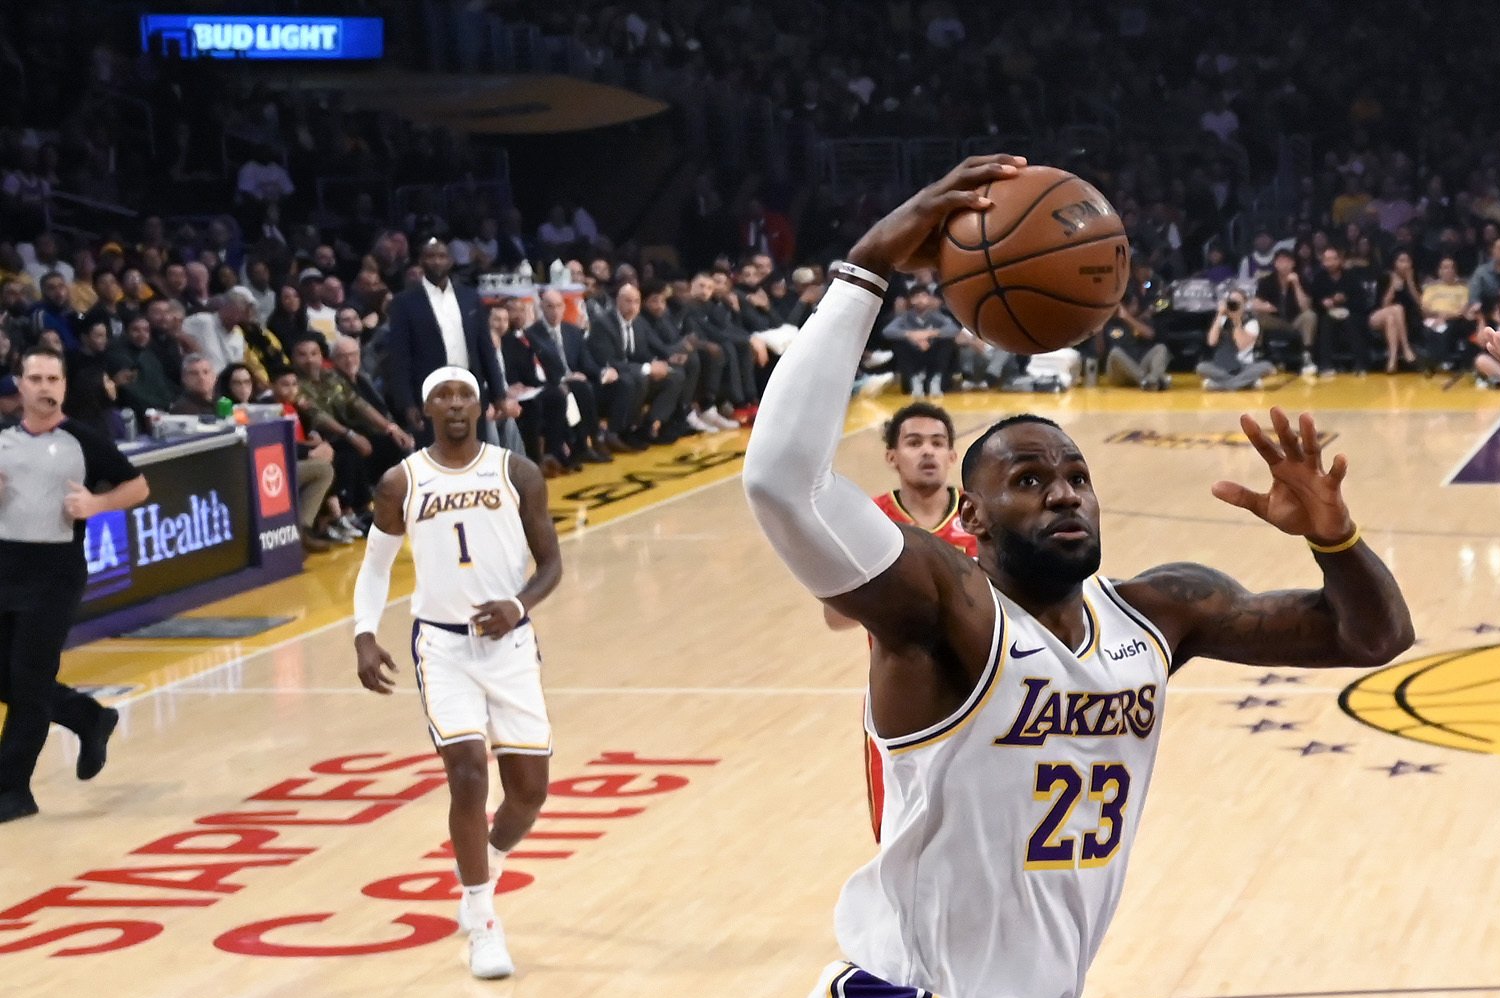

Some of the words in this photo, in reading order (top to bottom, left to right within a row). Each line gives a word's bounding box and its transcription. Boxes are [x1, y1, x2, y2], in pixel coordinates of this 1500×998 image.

[193, 23, 254, 50] BUD
[256, 24, 338, 50] LIGHT
[416, 488, 502, 523] LAKERS
[83, 520, 119, 574] LA
[132, 488, 234, 566] Health
[259, 524, 300, 551] TOYOTA
[453, 522, 473, 569] 1
[1104, 639, 1148, 661] wish
[992, 676, 1157, 746] LAKERS
[1024, 760, 1131, 871] 23
